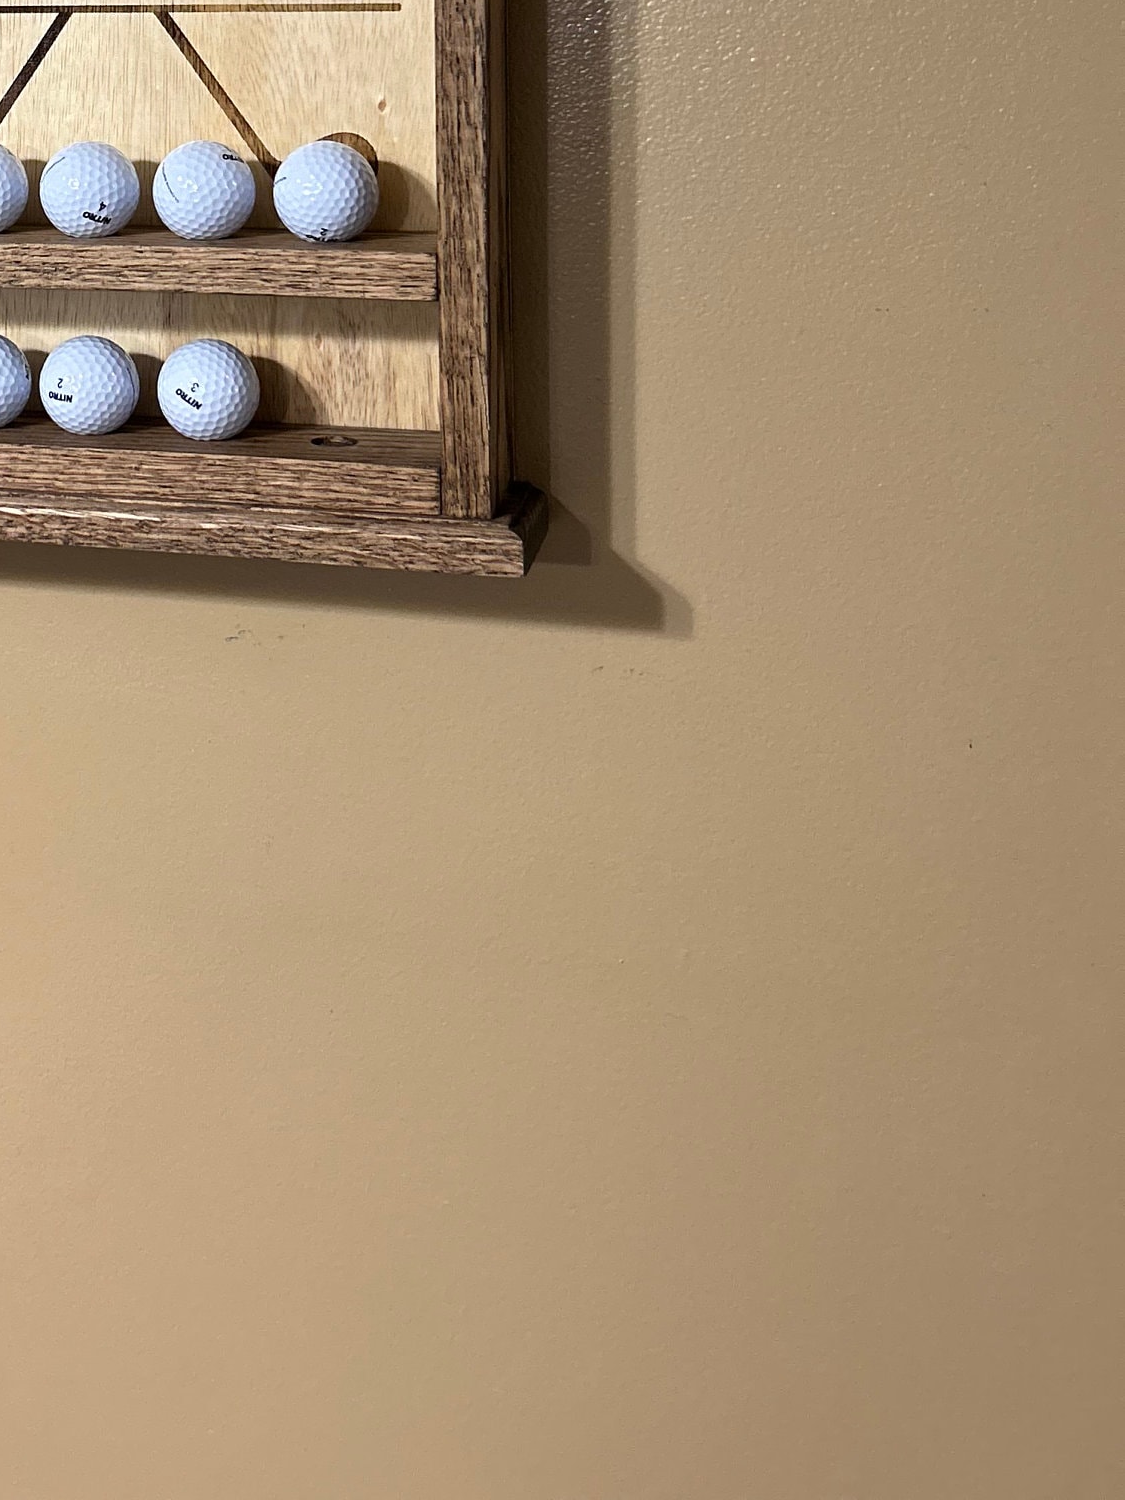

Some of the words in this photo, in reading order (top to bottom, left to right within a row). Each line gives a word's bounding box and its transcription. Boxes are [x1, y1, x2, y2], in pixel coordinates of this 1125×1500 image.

[98, 201, 107, 211] 4
[82, 211, 112, 225] NITRO
[57, 377, 64, 389] 2
[190, 382, 200, 393] 3
[48, 391, 73, 403] NITRO
[175, 388, 203, 410] NITRO
